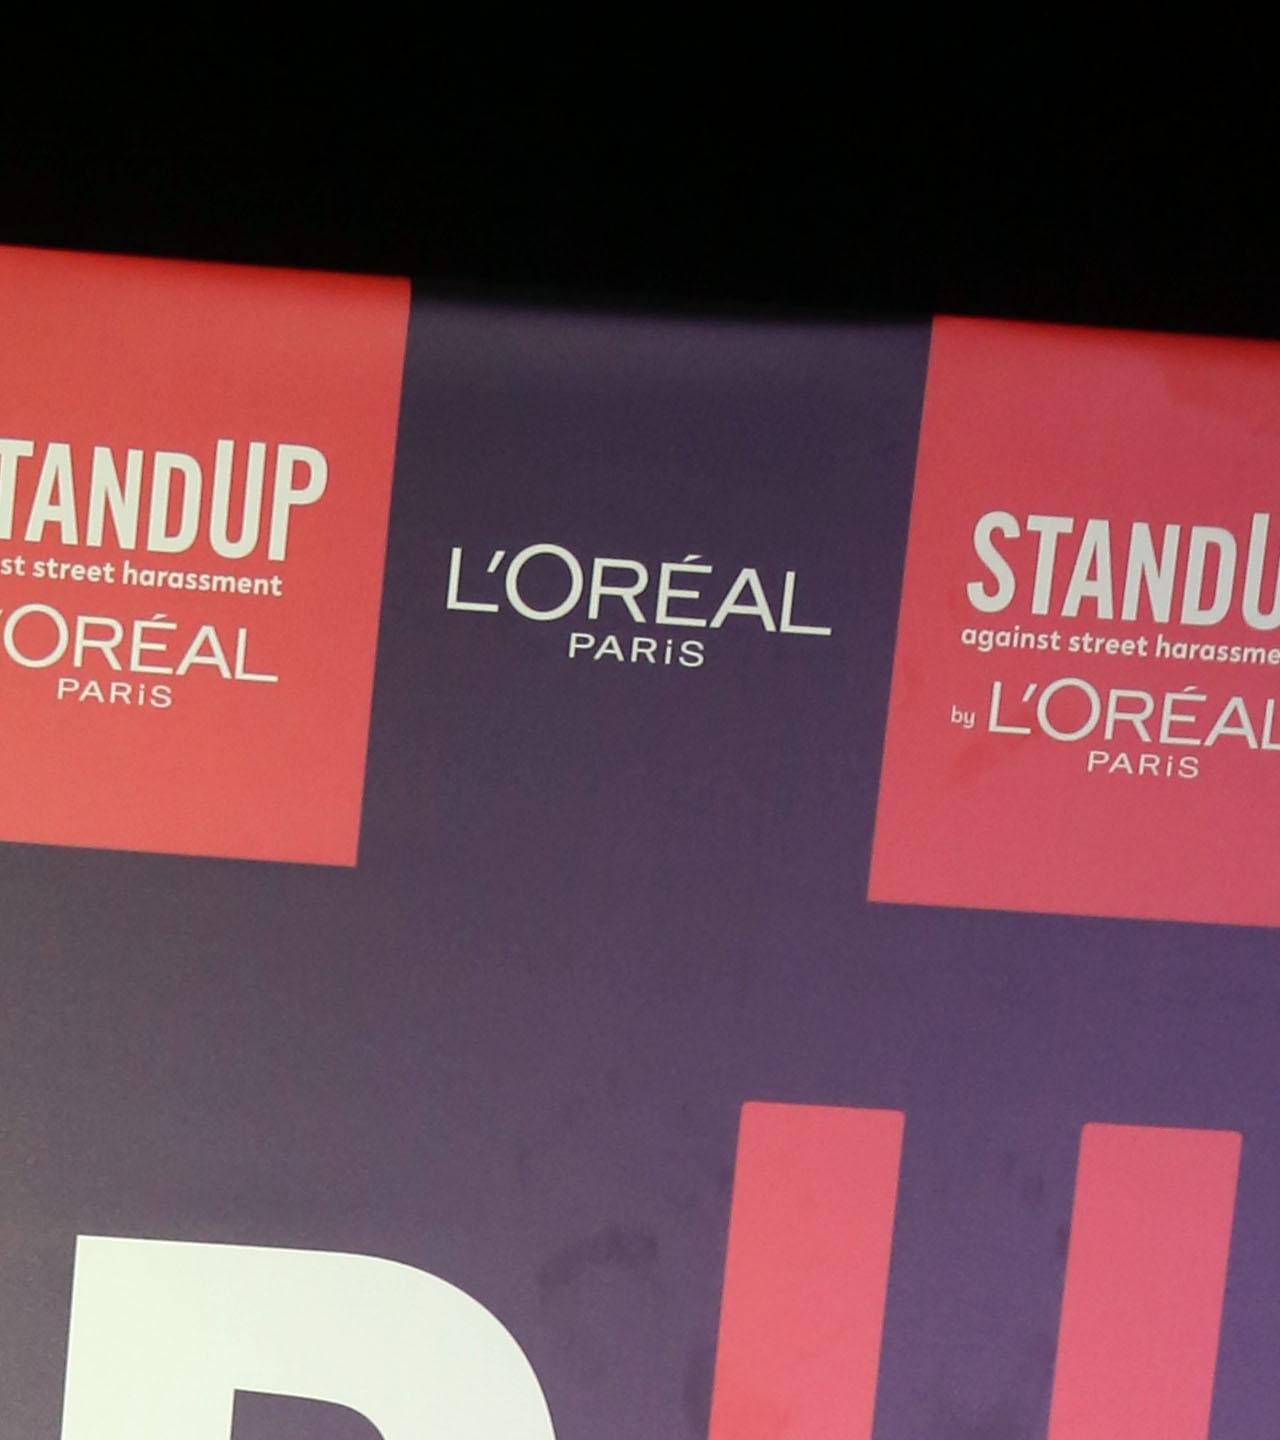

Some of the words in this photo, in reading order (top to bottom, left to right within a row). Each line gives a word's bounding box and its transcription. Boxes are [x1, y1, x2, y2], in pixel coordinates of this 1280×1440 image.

[31, 556, 117, 585] street
[121, 558, 284, 598] harassment
[445, 542, 833, 637] L'ORÉAL
[960, 623, 1063, 654] against
[1066, 631, 1150, 658] street
[949, 703, 977, 730] by
